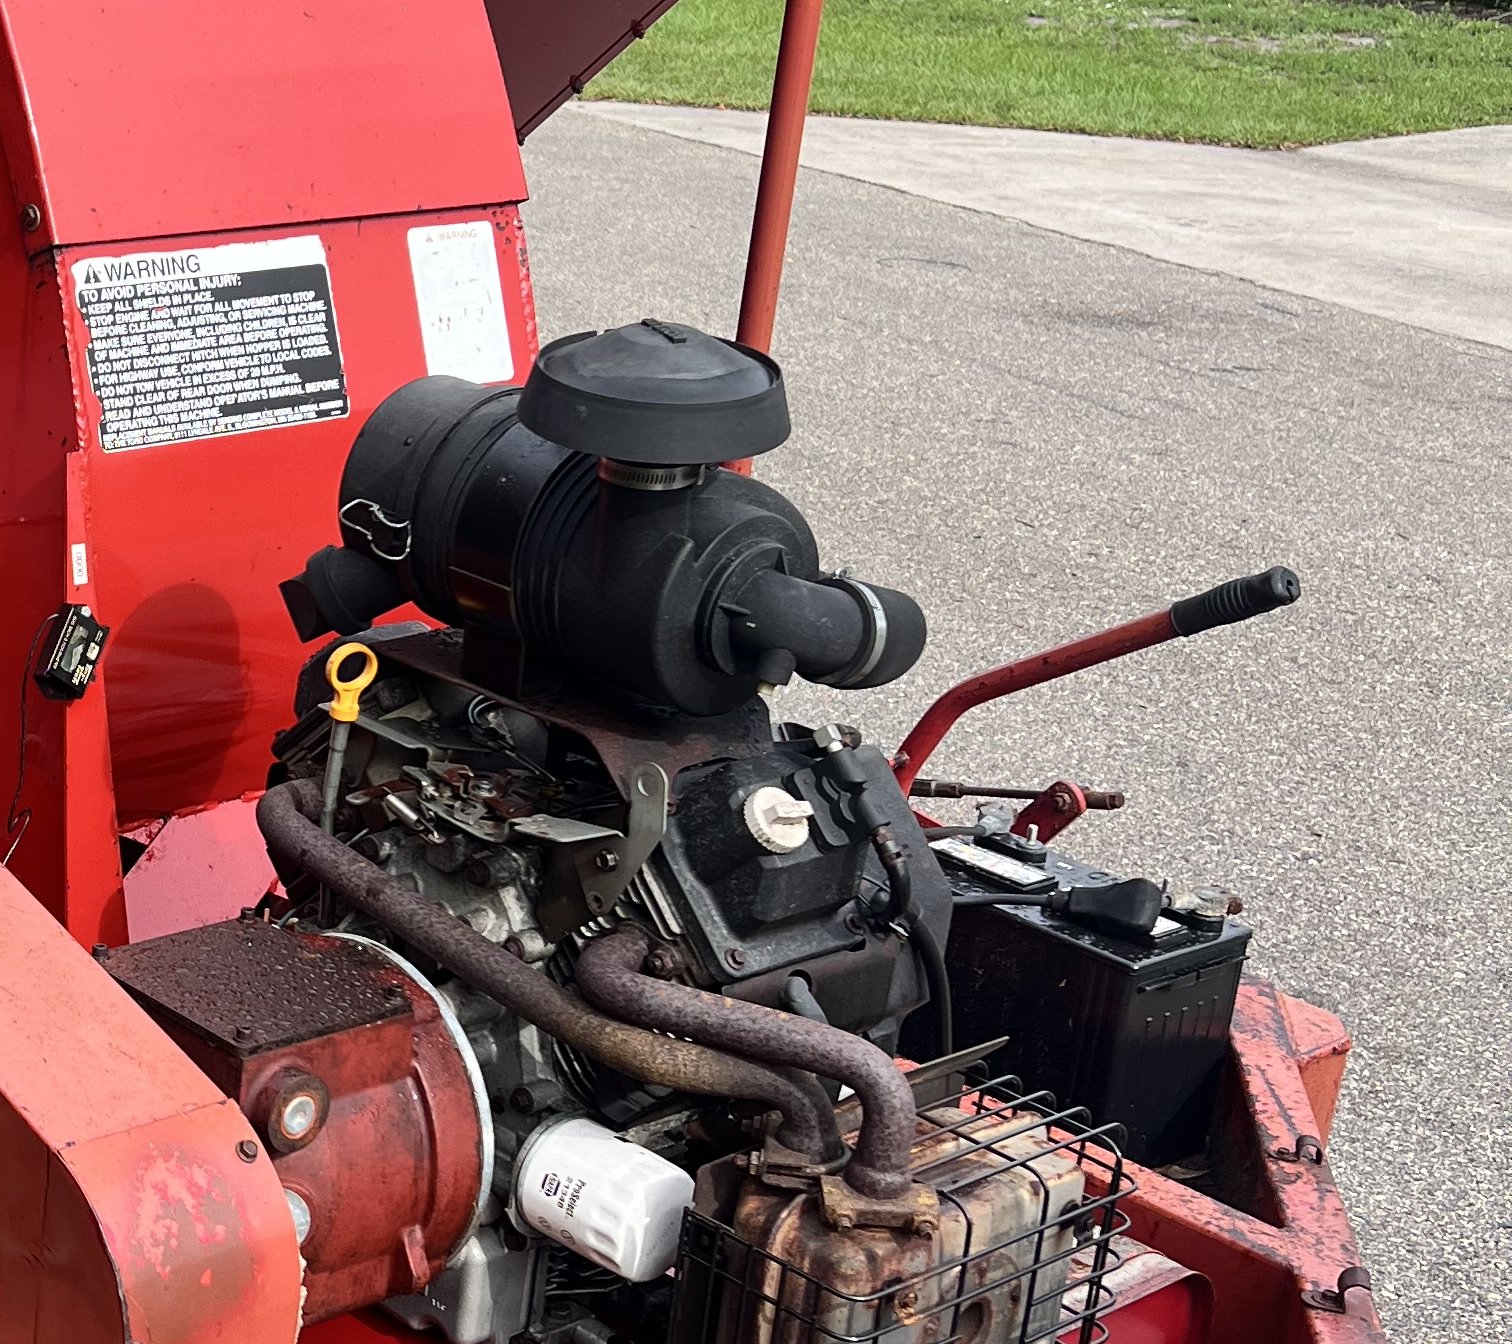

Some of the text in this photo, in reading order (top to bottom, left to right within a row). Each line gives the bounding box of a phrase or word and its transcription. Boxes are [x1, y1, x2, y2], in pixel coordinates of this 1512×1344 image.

[103, 254, 201, 282] WARNING
[81, 290, 99, 303] TO
[99, 286, 135, 301] AVOID
[135, 278, 198, 297] PERSONAL
[87, 291, 214, 315] KEEP ALL SHIELDS IN PLACE.
[89, 290, 316, 327] STOP ENGINE AND WAIT FOR ALL MOVEMENT TO STOP
[90, 325, 128, 339] BEFORE
[128, 319, 176, 334] CLEANING,
[227, 311, 241, 321] OR
[241, 305, 286, 319] SERVICING
[287, 300, 327, 314] MACHINE.
[92, 338, 120, 350] MAKE
[120, 334, 146, 347] SURE
[195, 322, 242, 337] INCLUDING
[287, 315, 297, 325] IS
[297, 312, 326, 324] CLEAR
[94, 323, 328, 361] OF MACHINE AND IMMEDIATE AREA BEFORE OPERATING.
[97, 334, 328, 374] DO NOT DISCONNECT HITCH WHEN HOPPER IS LOADED.
[98, 345, 332, 386] FOR HIGHWAY USE, CONFORM VEHICLE TO LOCAL CODES.
[100, 387, 115, 398] DO
[115, 384, 135, 396] NOT
[134, 381, 155, 393] TOW
[154, 376, 192, 390] VEHICLE
[191, 375, 202, 385] IN
[202, 370, 236, 384] EXCESS
[236, 368, 250, 379] OF
[249, 367, 260, 377] 20
[102, 373, 302, 410] STAND CLEAR OF REAR DOOR WHEN DUMPING.
[104, 409, 131, 422] READ
[131, 406, 153, 418] AND
[152, 397, 212, 415] UNDERSTAND
[268, 384, 305, 398] MANUAL
[304, 379, 340, 393] BEFORE
[105, 416, 158, 433] OPERATING
[157, 413, 179, 425] THIS
[179, 407, 223, 422] MACHINE.
